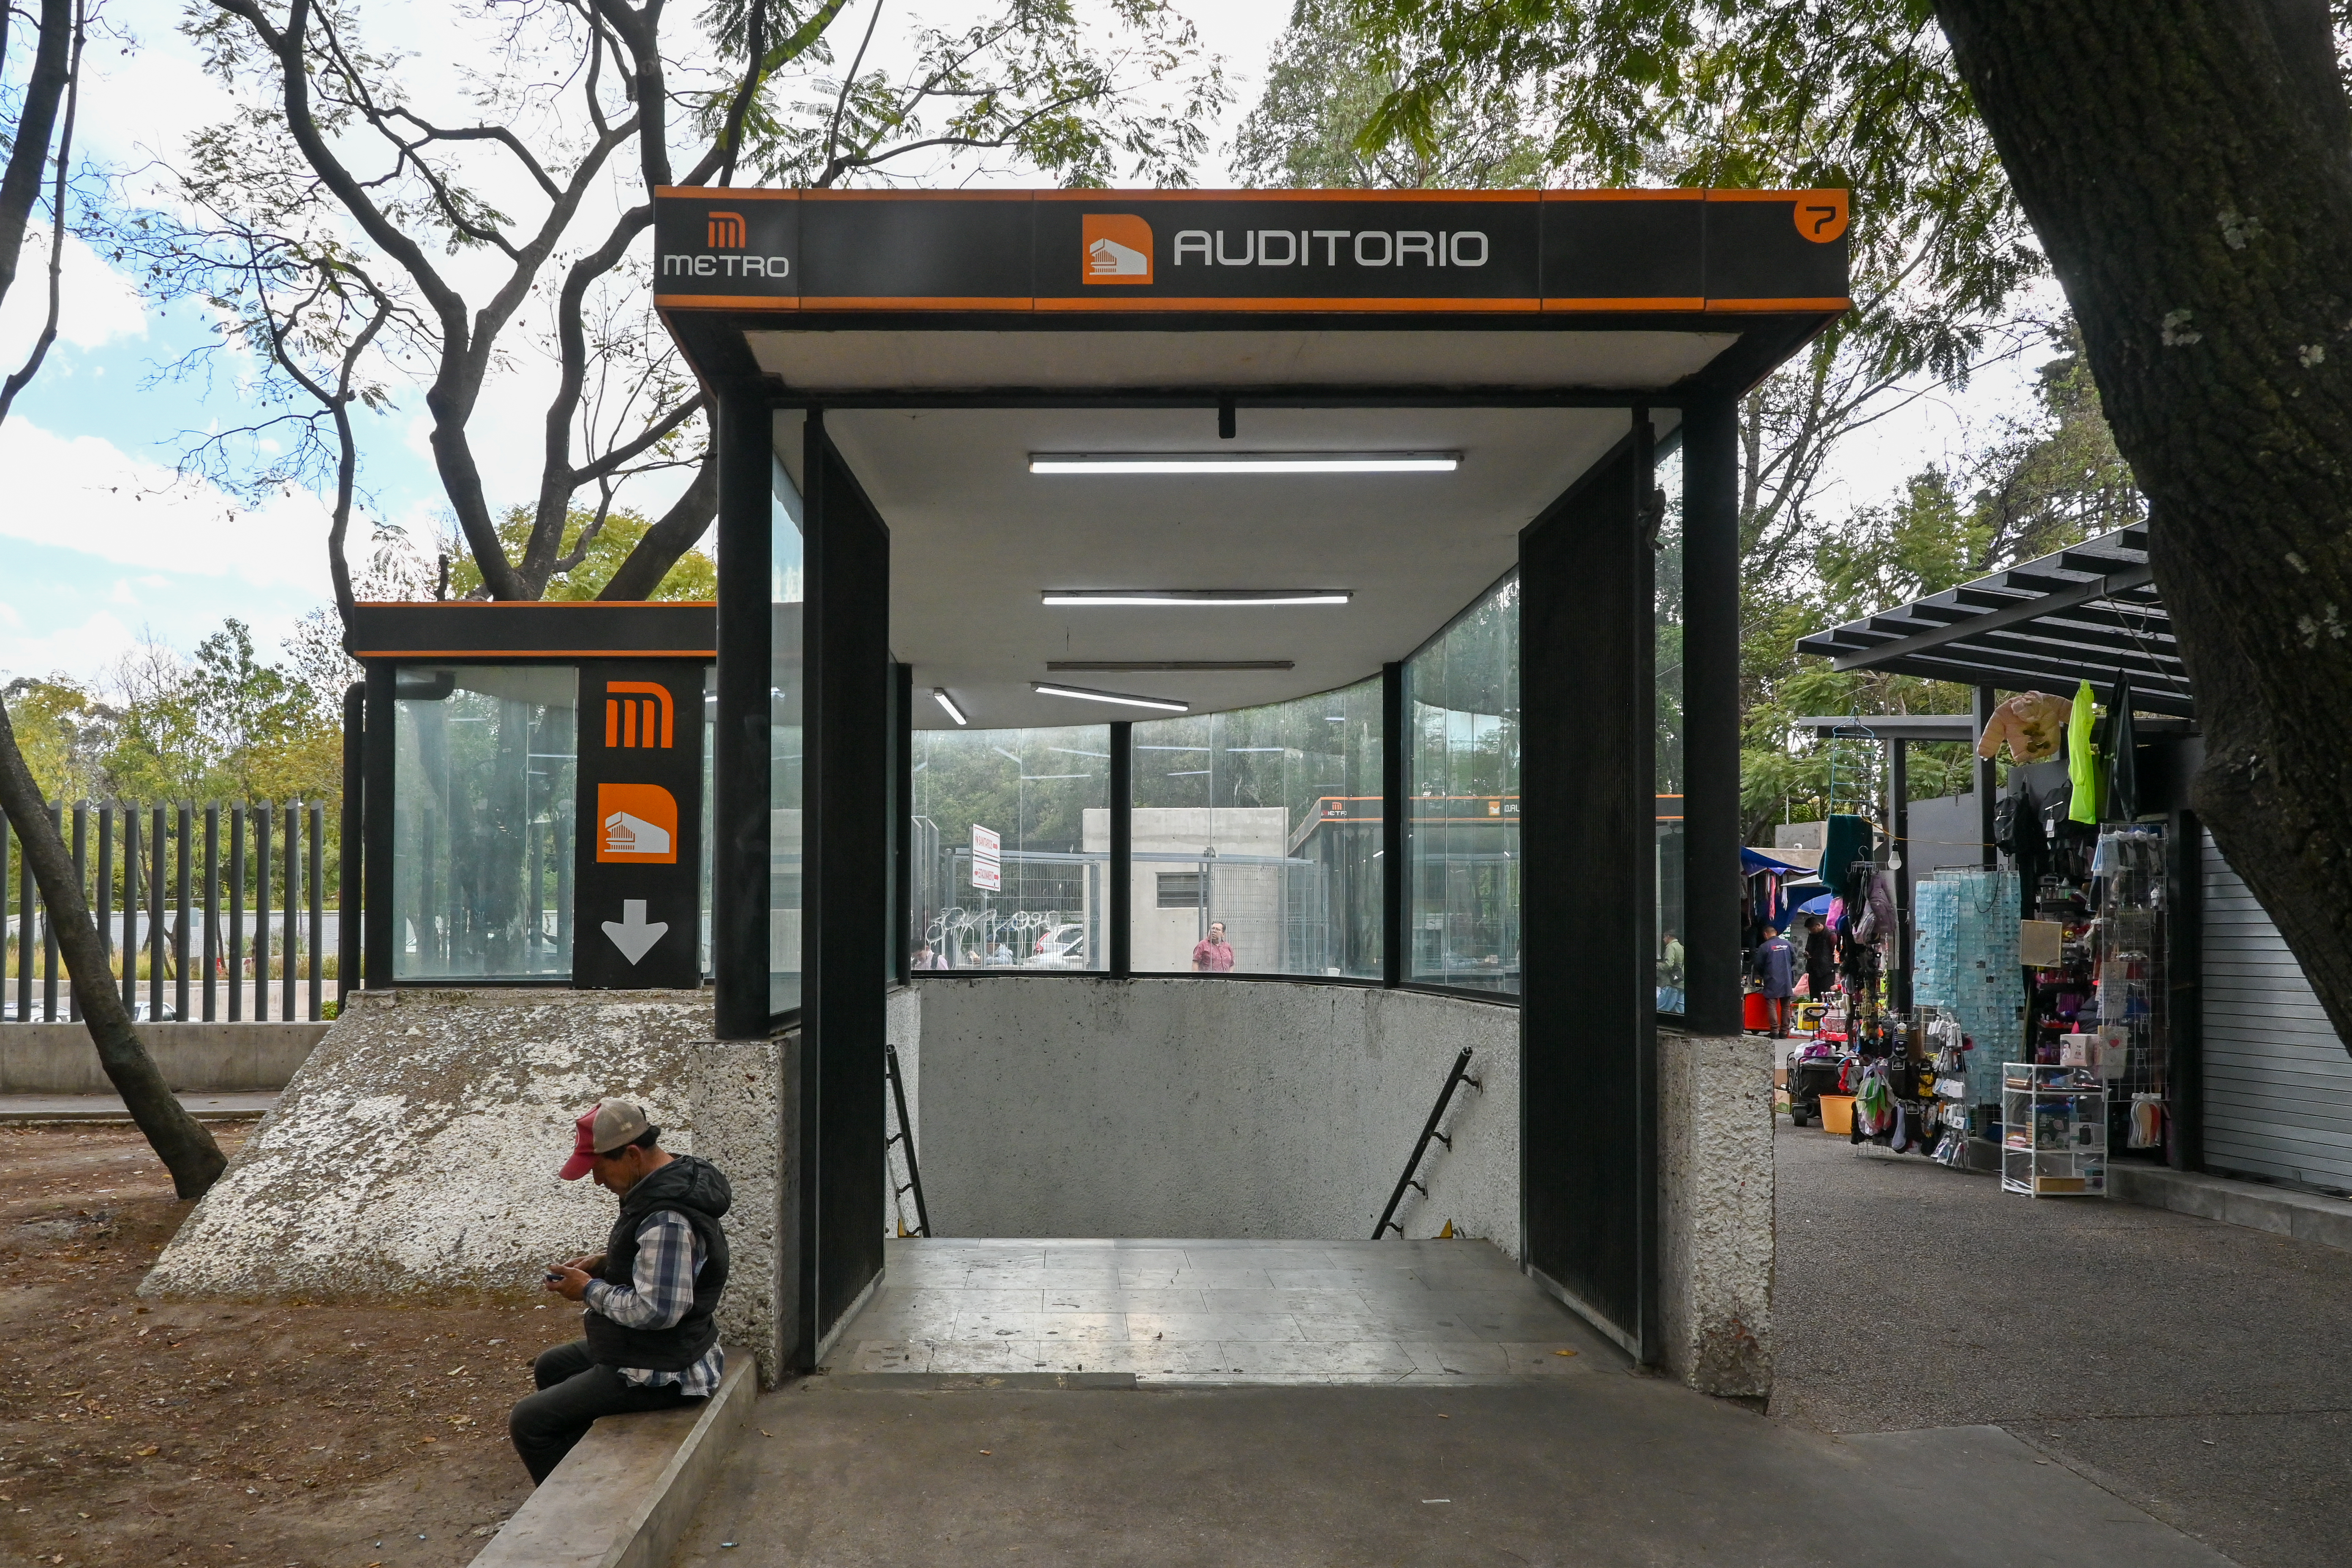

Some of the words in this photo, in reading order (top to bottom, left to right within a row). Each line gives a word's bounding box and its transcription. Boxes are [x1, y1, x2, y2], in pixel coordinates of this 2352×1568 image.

[1806, 206, 1836, 234] 7
[1174, 230, 1489, 267] AUDITORIO
[664, 255, 789, 278] METRO
[978, 835, 993, 850] SANITARIOS
